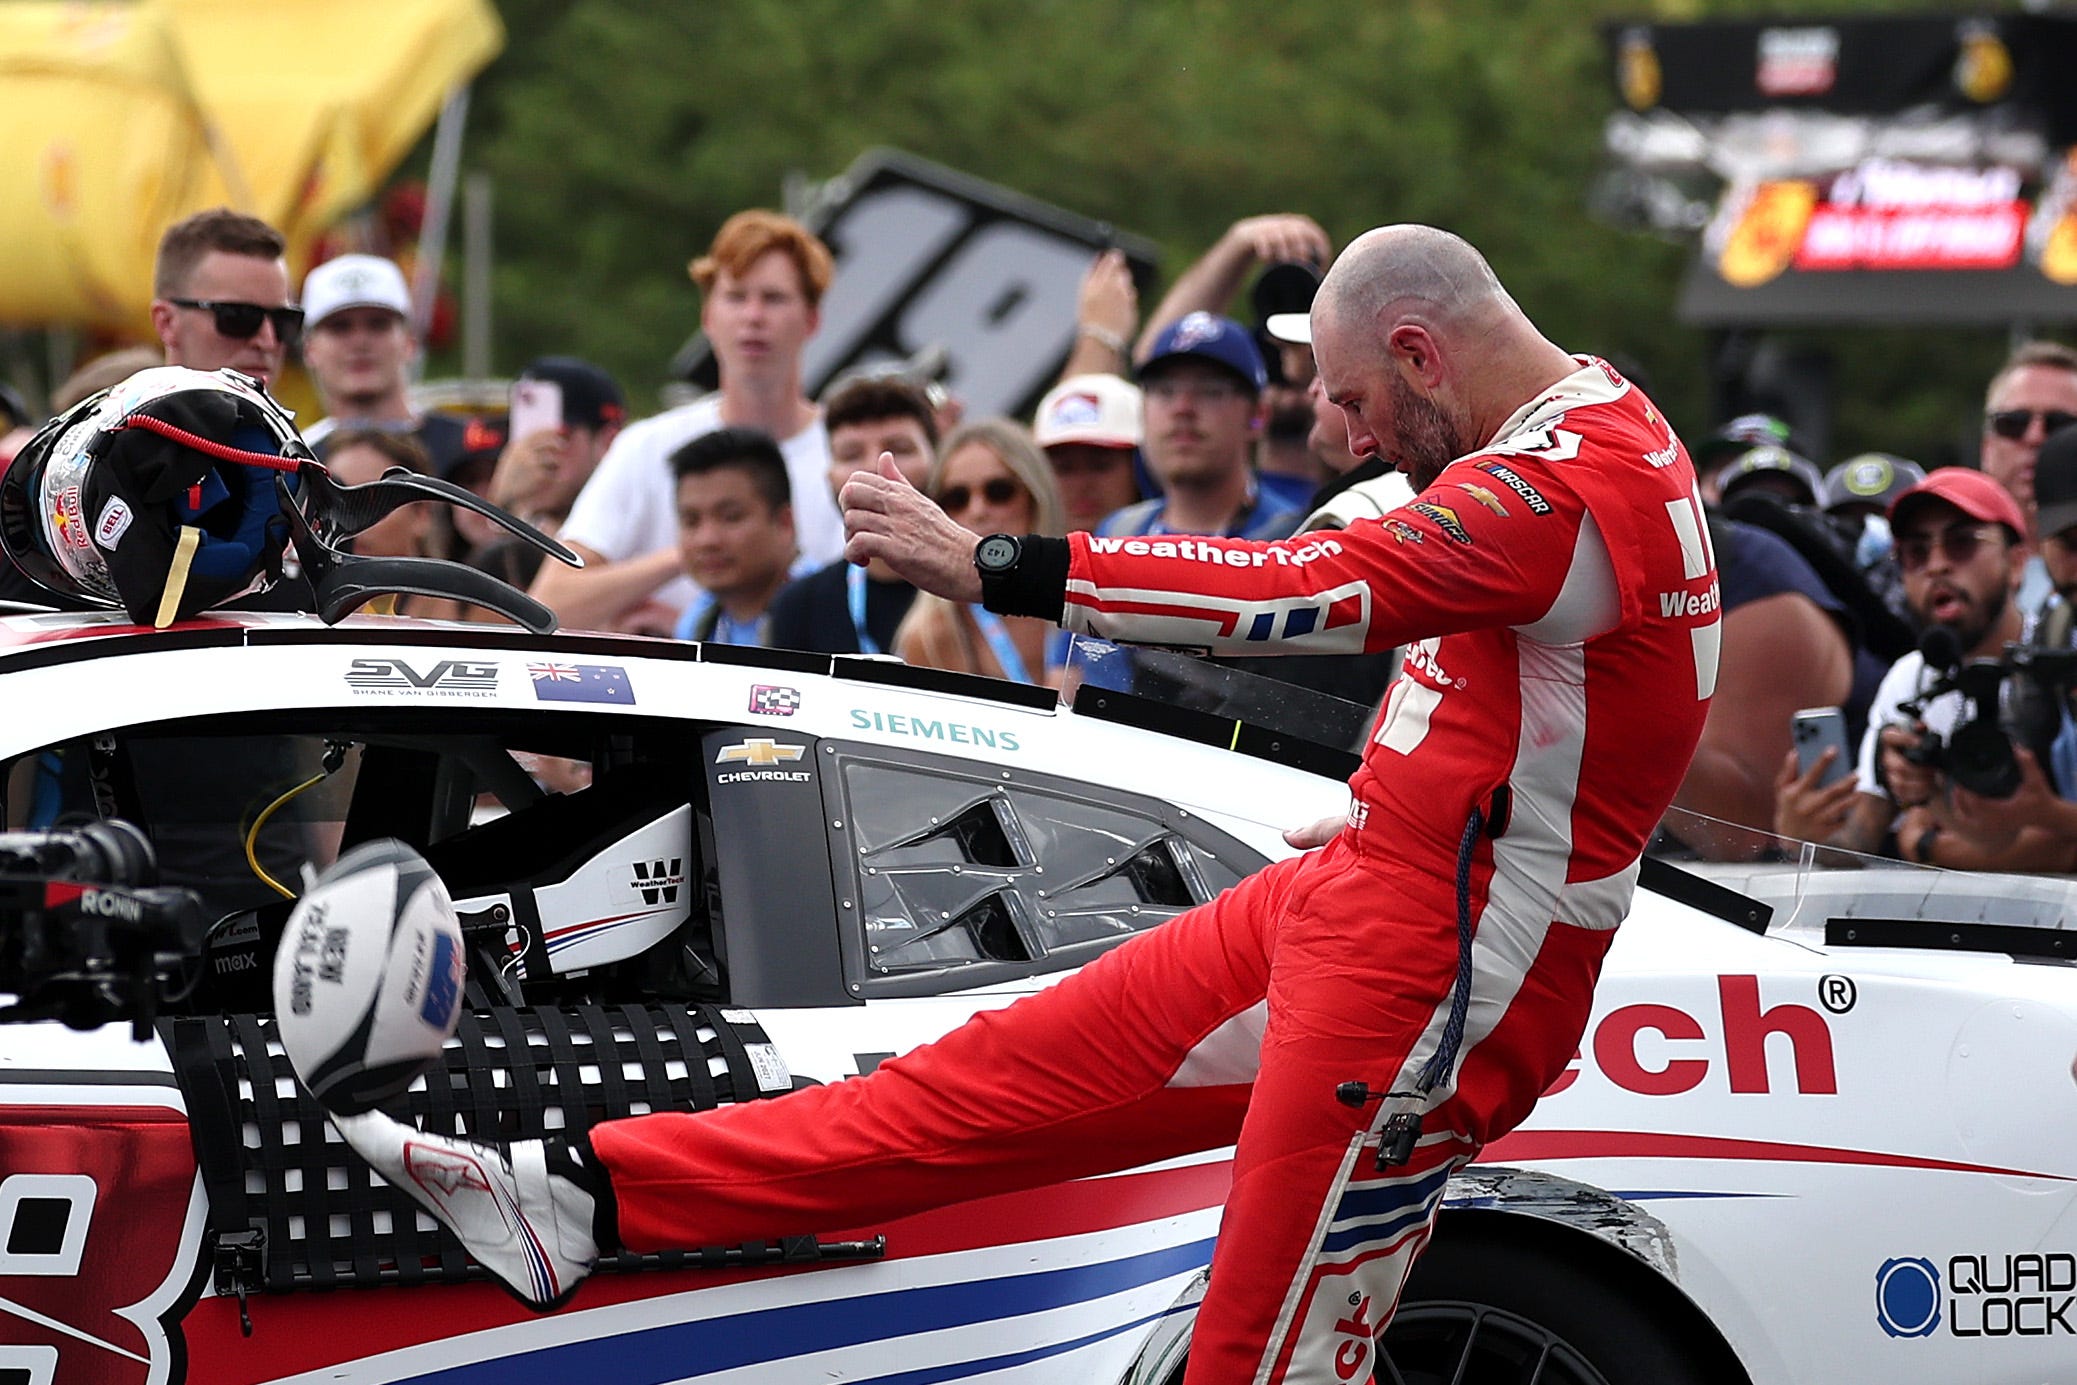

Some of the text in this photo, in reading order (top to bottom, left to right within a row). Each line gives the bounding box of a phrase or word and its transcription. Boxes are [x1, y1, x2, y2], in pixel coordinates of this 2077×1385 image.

[1492, 468, 1550, 513] NASCAR
[103, 508, 123, 535] BELL
[344, 658, 501, 688] SVG
[426, 690, 497, 698] GISBERGEN
[850, 709, 1020, 751] SIEMENS
[717, 771, 812, 785] CHEVROLET
[214, 951, 258, 975] max
[1949, 1253, 2077, 1295] QUAD
[1949, 1296, 2077, 1337] LOCK
